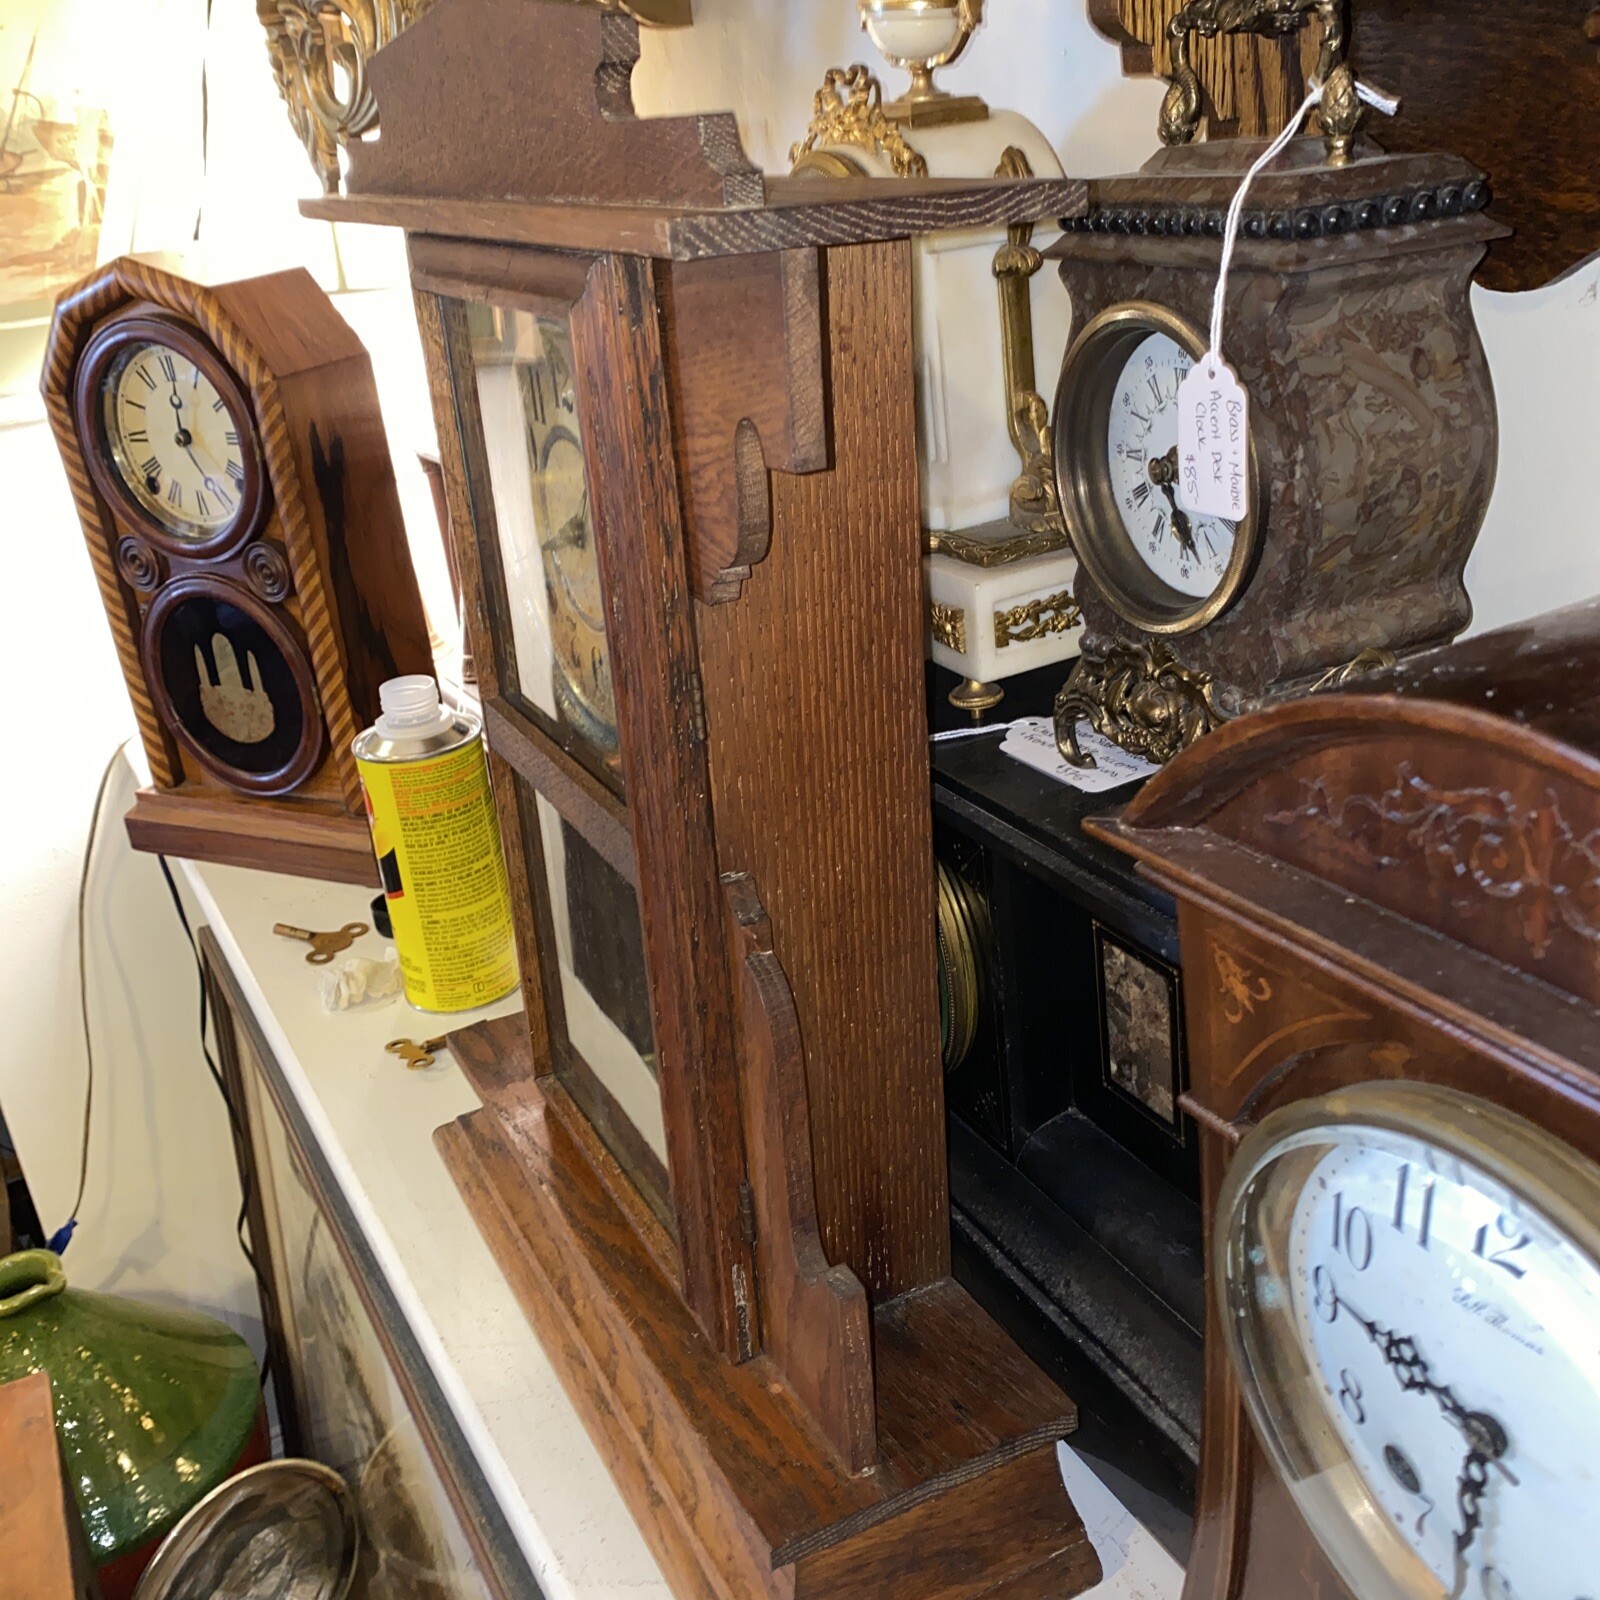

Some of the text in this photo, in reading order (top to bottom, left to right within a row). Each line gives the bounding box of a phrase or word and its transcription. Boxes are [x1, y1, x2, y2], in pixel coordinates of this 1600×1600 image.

[1195, 402, 1207, 452] Clock
[1209, 389, 1223, 484] Accent Desk
[1225, 399, 1242, 443] Brass
[1228, 460, 1244, 512] Marble
[1332, 1191, 1373, 1272] 10
[1391, 1163, 1436, 1252] 11
[1471, 1211, 1532, 1280] 12
[1312, 1265, 1341, 1324] 9
[1338, 1367, 1367, 1425] 8
